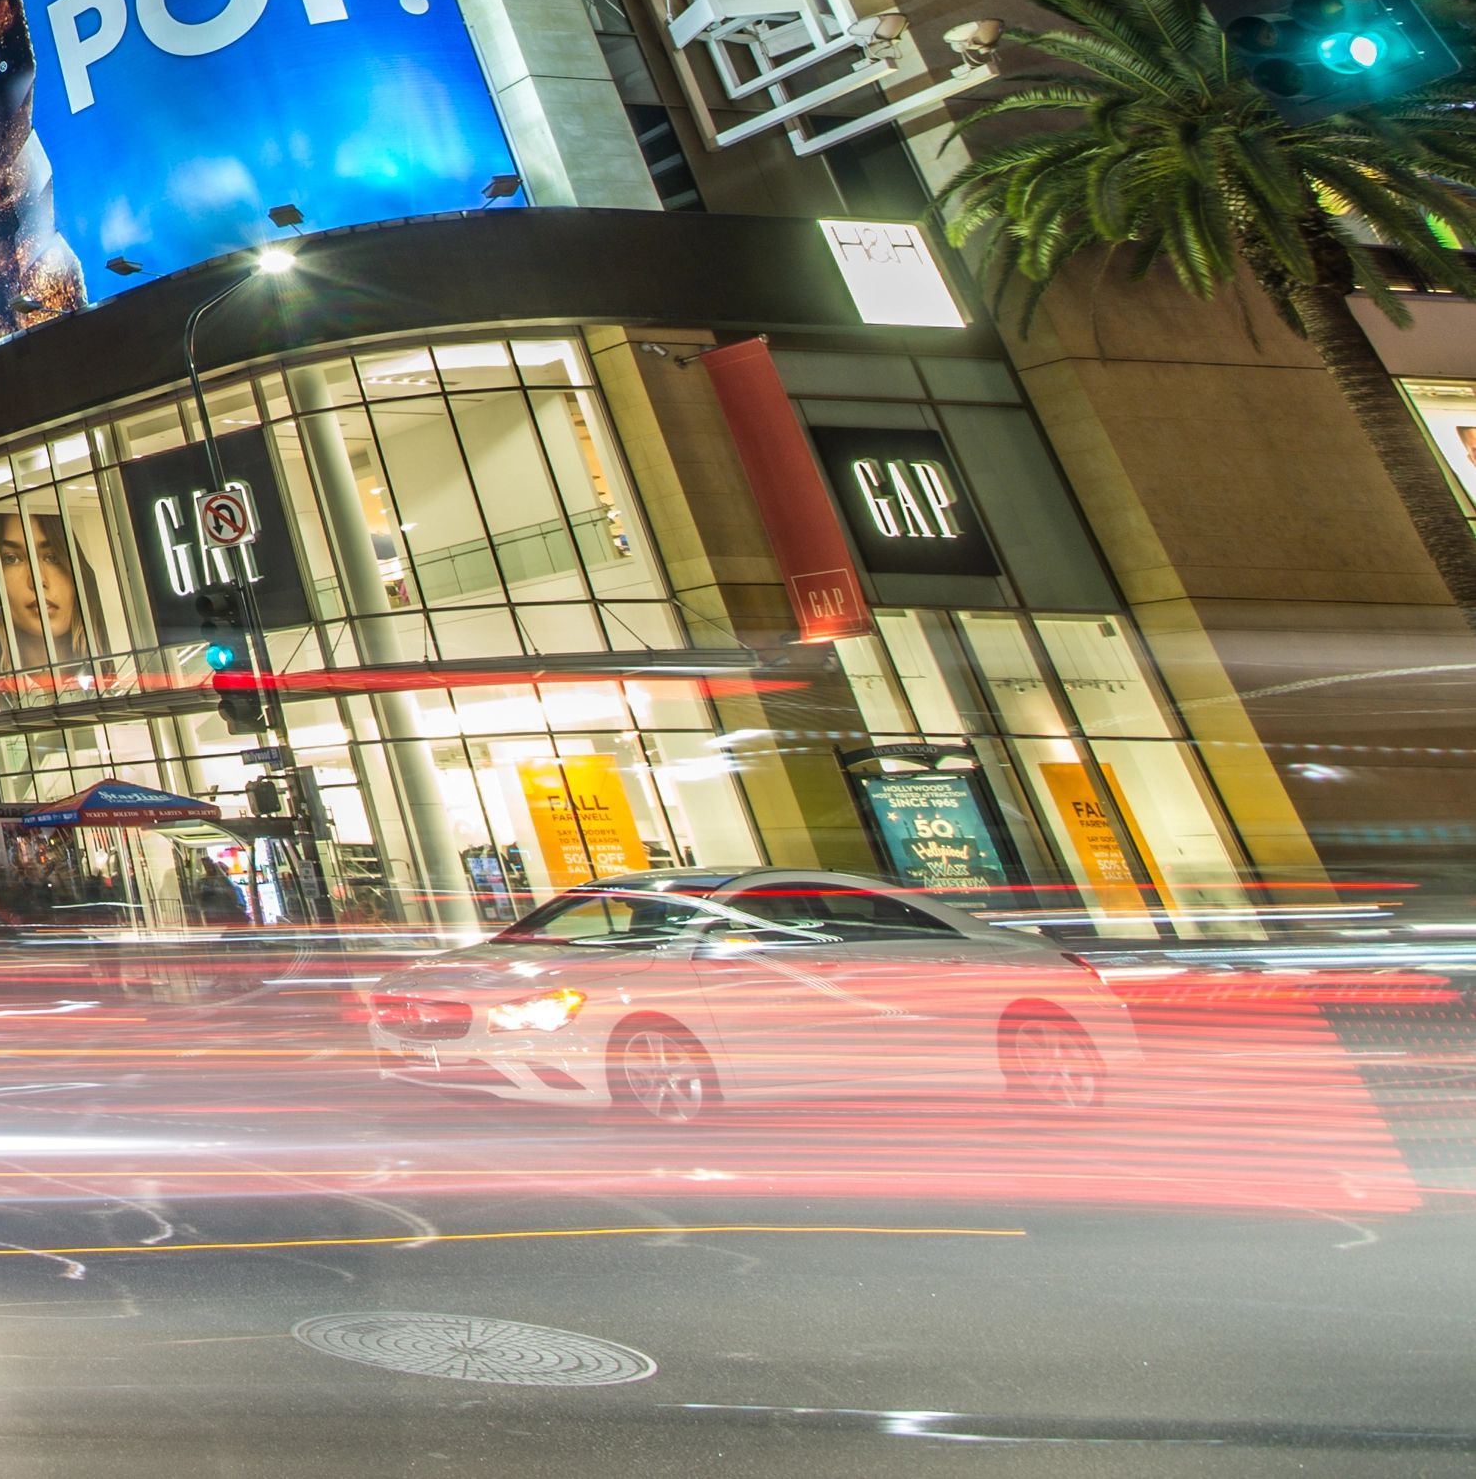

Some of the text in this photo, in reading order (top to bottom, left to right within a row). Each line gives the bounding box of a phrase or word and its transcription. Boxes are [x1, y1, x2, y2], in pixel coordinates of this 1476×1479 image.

[852, 458, 961, 540] GAP
[808, 586, 846, 620] GAP
[872, 745, 938, 756] HOLLYWOOD
[882, 784, 952, 793] HOLLYWOOD'S
[889, 798, 959, 809] SINCE 1965
[85, 811, 109, 819] TICKETS
[113, 810, 139, 818] BOLETOS
[1071, 801, 1107, 818] FAL
[552, 813, 613, 821] FARWELL
[1079, 820, 1110, 828] FAREW
[574, 828, 618, 836] OODBYE
[596, 852, 626, 864] OFF
[911, 841, 970, 865] Hollywood
[567, 865, 587, 874] SAL
[924, 875, 990, 892] MUSEUM
